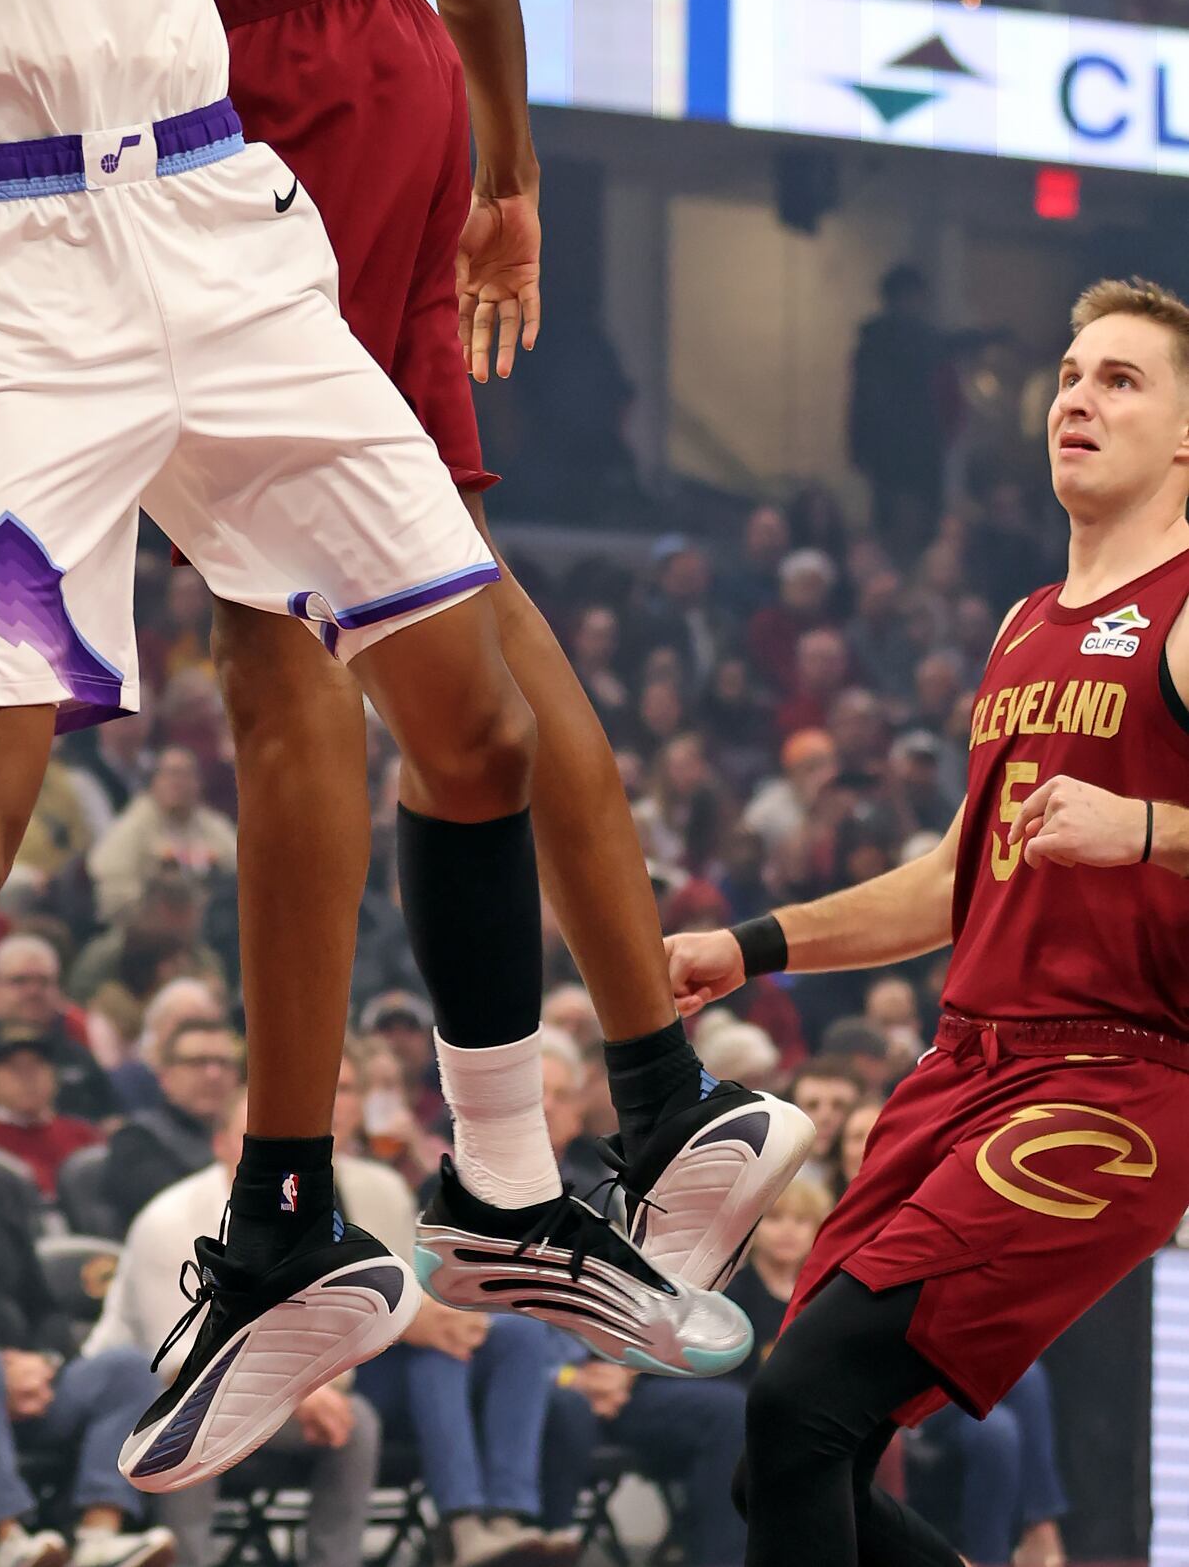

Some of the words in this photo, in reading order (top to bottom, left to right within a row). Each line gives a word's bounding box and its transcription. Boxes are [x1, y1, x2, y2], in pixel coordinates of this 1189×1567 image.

[1059, 54, 1189, 149] CL
[1084, 636, 1136, 653] CLIFFS
[969, 680, 1128, 752] CLEVELAND
[990, 762, 1039, 882] 5
